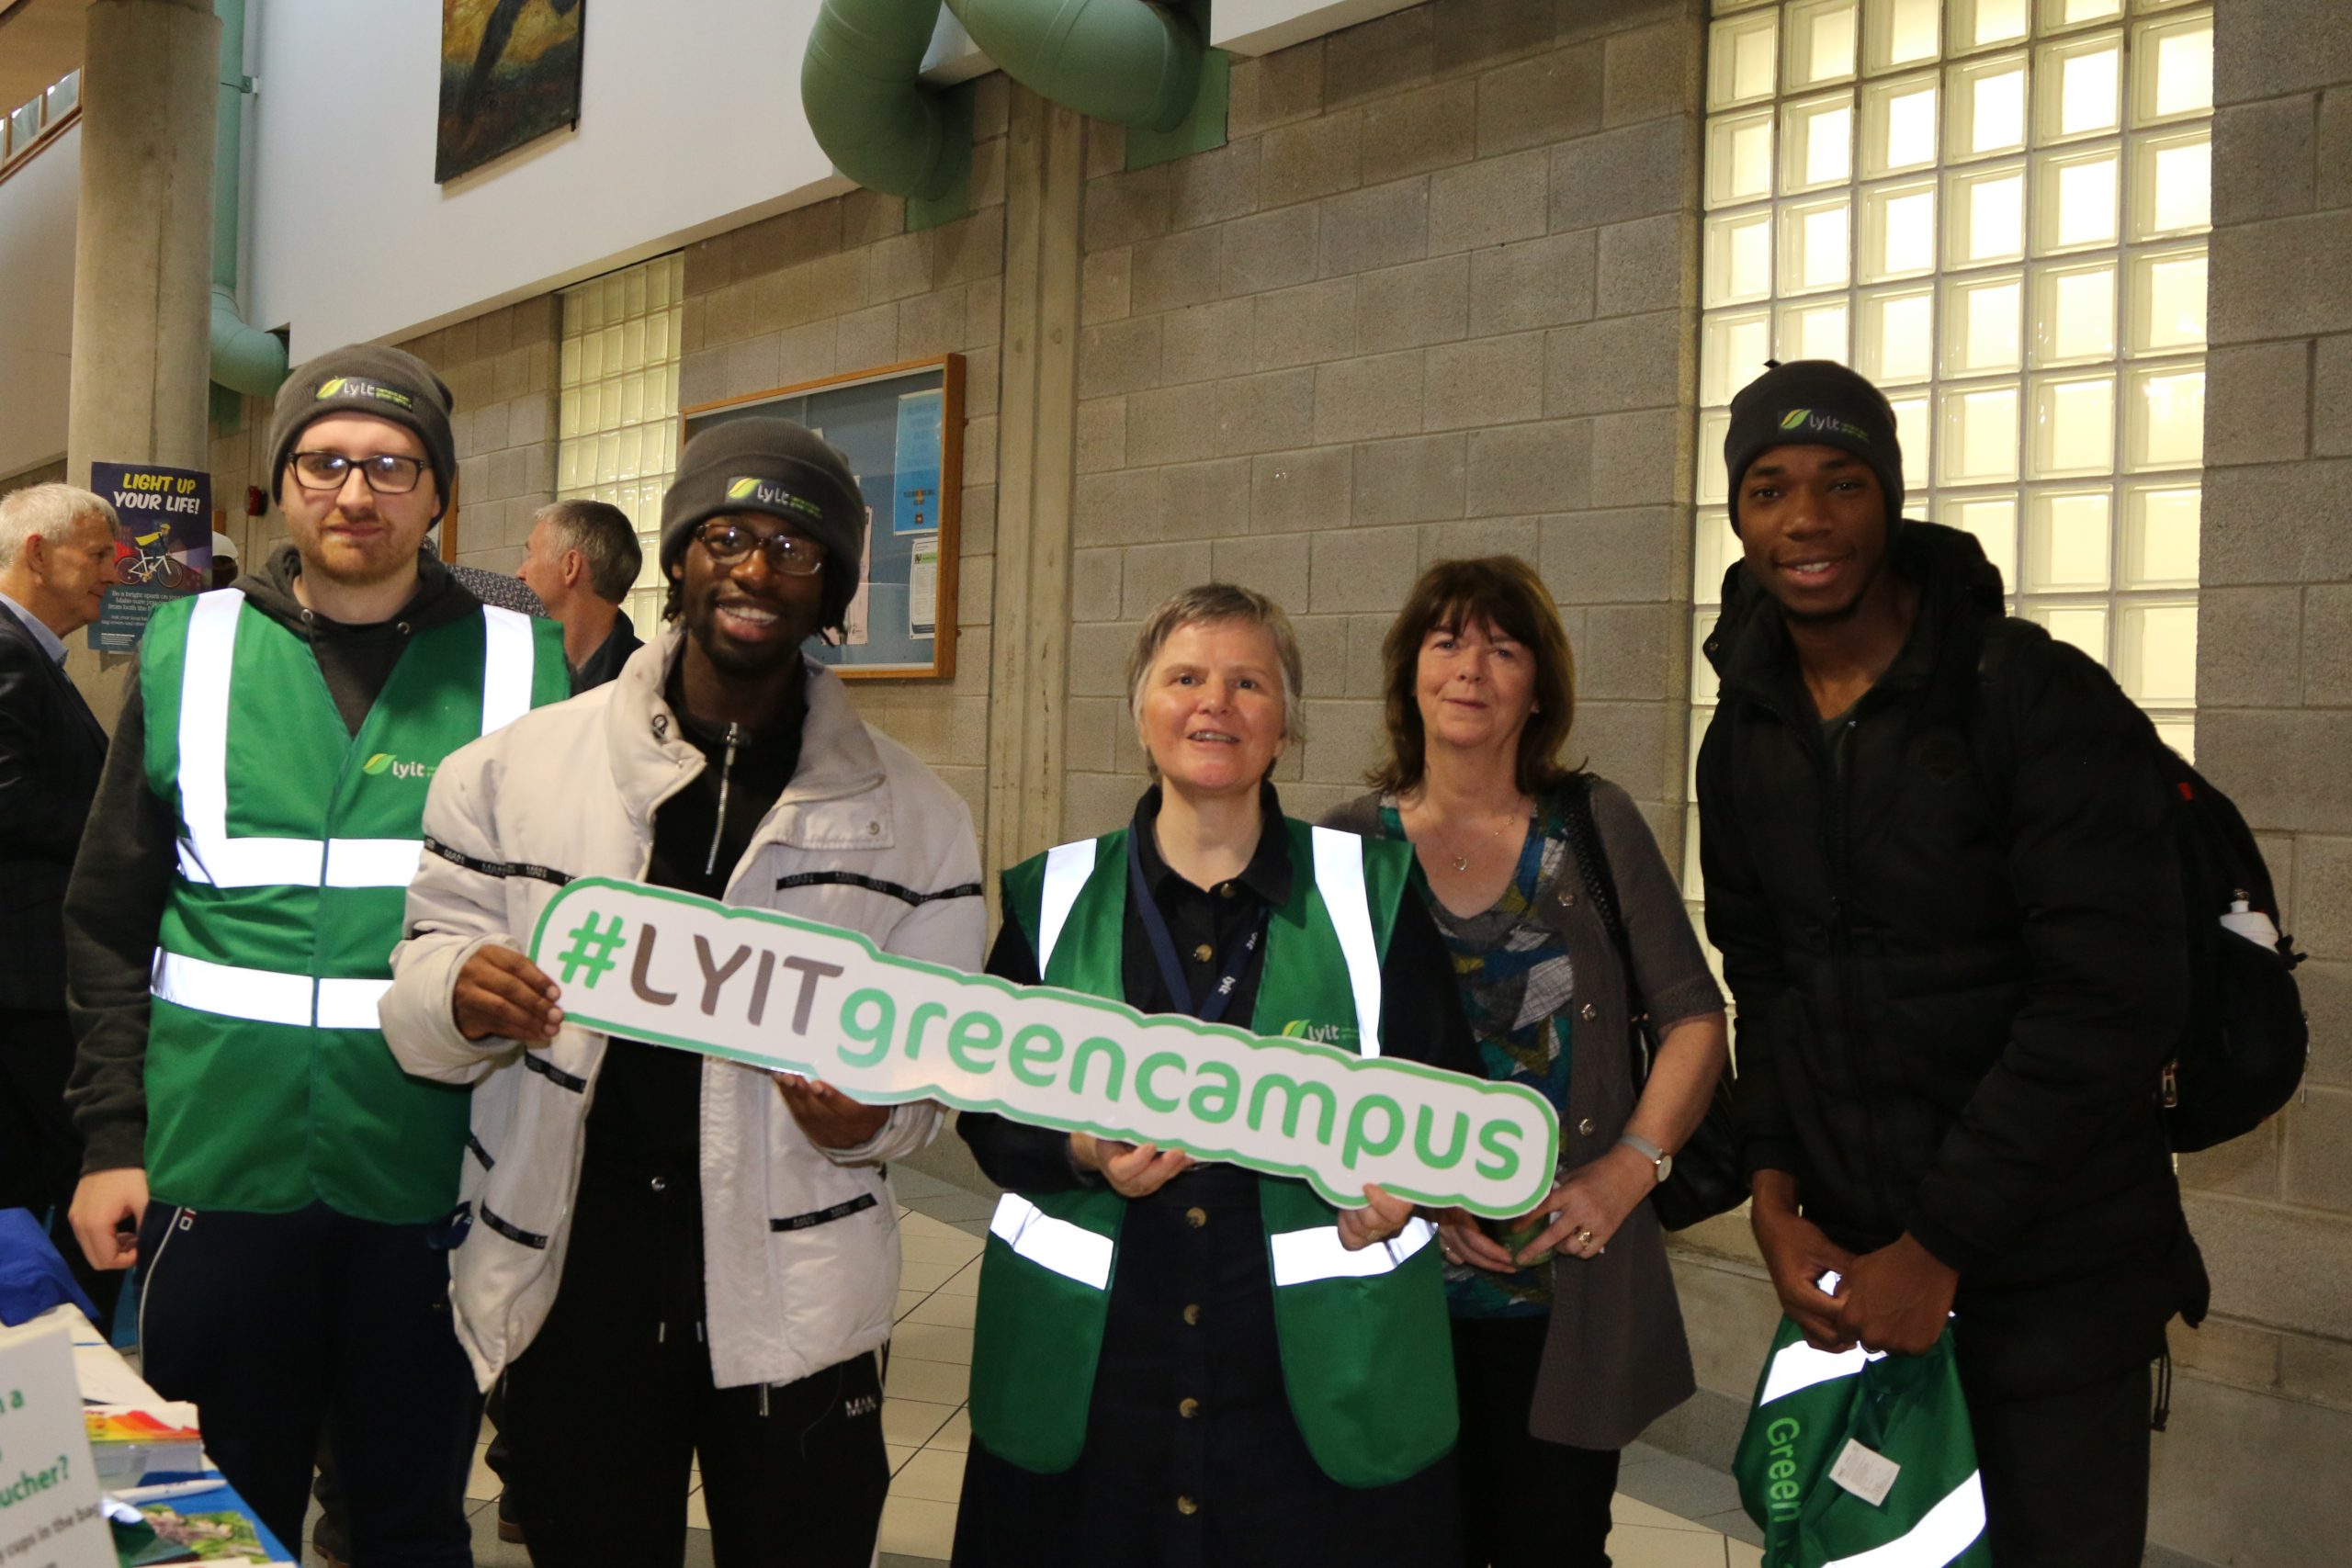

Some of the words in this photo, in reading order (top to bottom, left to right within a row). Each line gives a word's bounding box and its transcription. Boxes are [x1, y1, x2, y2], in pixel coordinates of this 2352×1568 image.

[122, 472, 174, 491] LIGHT
[176, 478, 197, 494] UP
[113, 491, 162, 511] YOUR
[165, 494, 200, 515] LIFE!
[392, 761, 425, 779] lyit
[1307, 1023, 1340, 1043] lyit
[557, 910, 1524, 1181] #LYITgreencampus
[1767, 1417, 1802, 1522] Green
